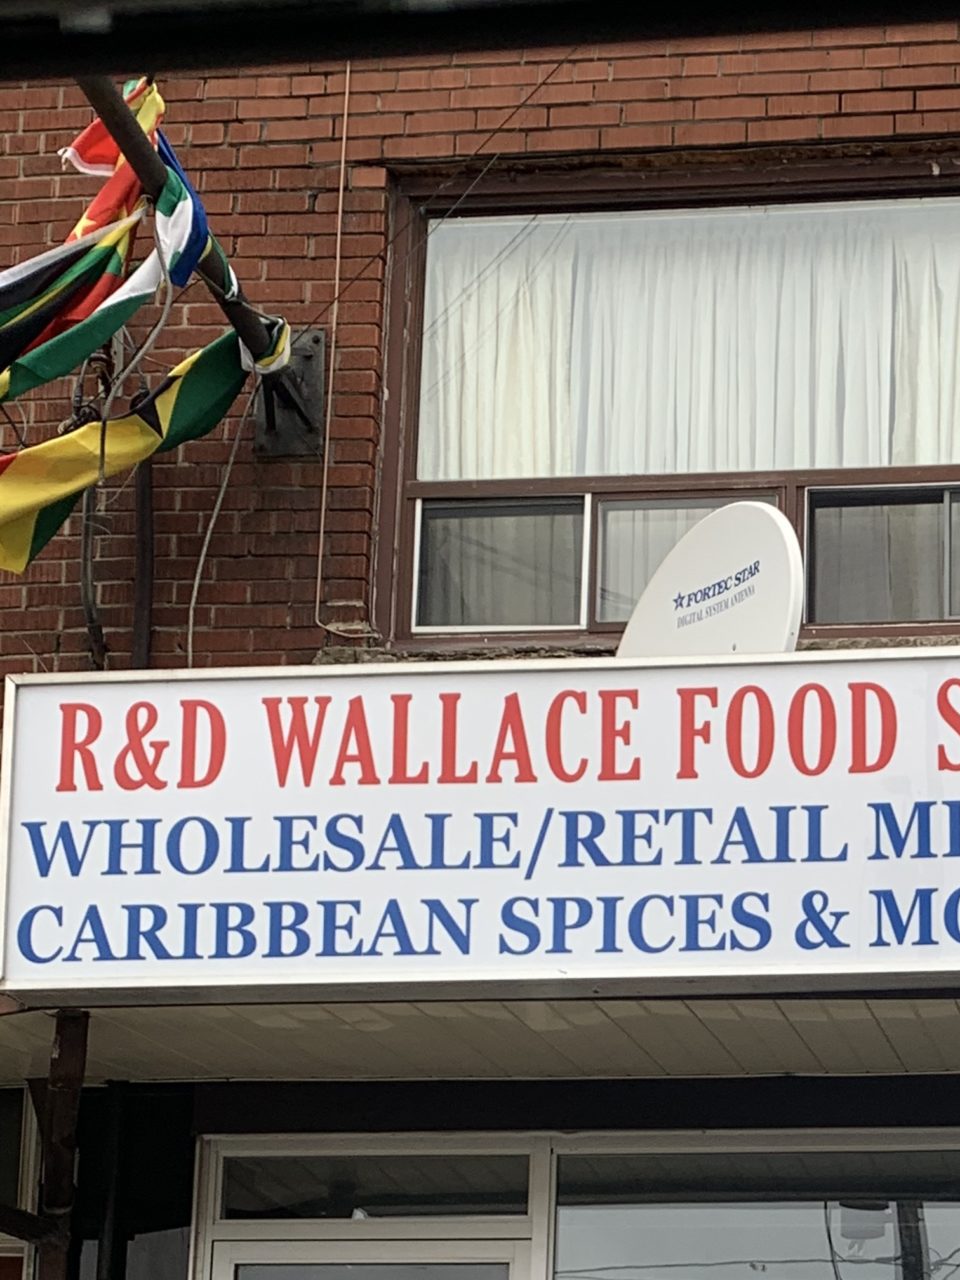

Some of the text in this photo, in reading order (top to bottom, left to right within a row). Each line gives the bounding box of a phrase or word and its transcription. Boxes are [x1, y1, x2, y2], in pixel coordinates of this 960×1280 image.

[677, 610, 703, 628] DIGITAL
[705, 599, 730, 619] SYSTEM
[686, 560, 760, 607] FORTEC STAR
[56, 700, 227, 792] R&D
[261, 689, 641, 787] WALLACE
[676, 682, 898, 780] FOOD
[20, 805, 848, 880] WHOLESALE/RETAIL
[16, 897, 479, 963] CARIBBEAN
[498, 890, 772, 954] SPICES
[794, 889, 851, 950] &
